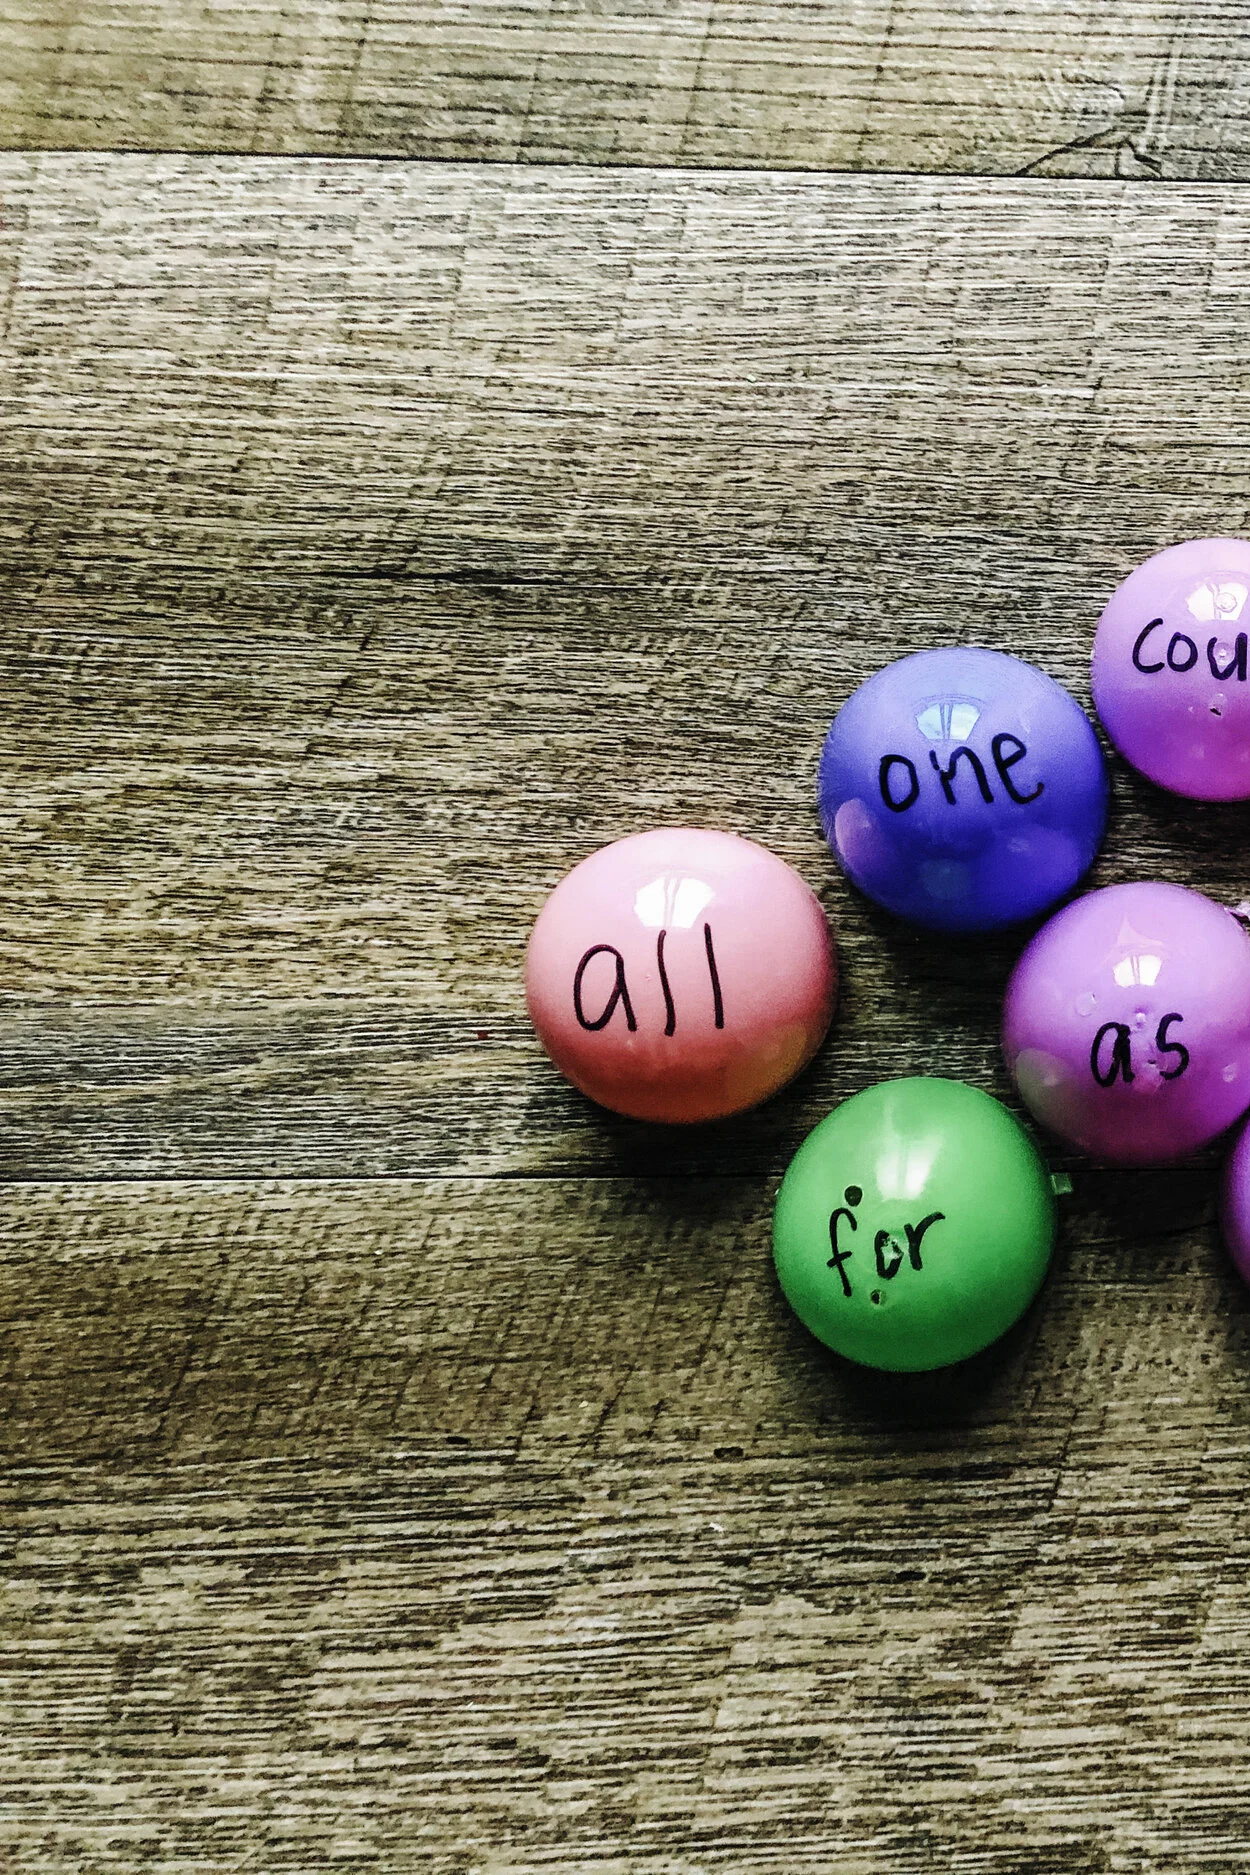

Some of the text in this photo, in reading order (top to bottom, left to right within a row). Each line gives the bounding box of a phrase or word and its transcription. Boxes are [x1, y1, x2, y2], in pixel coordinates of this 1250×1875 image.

[878, 731, 1046, 814] one
[573, 922, 725, 1037] all
[1089, 1012, 1190, 1088] as
[827, 1206, 946, 1298] for
